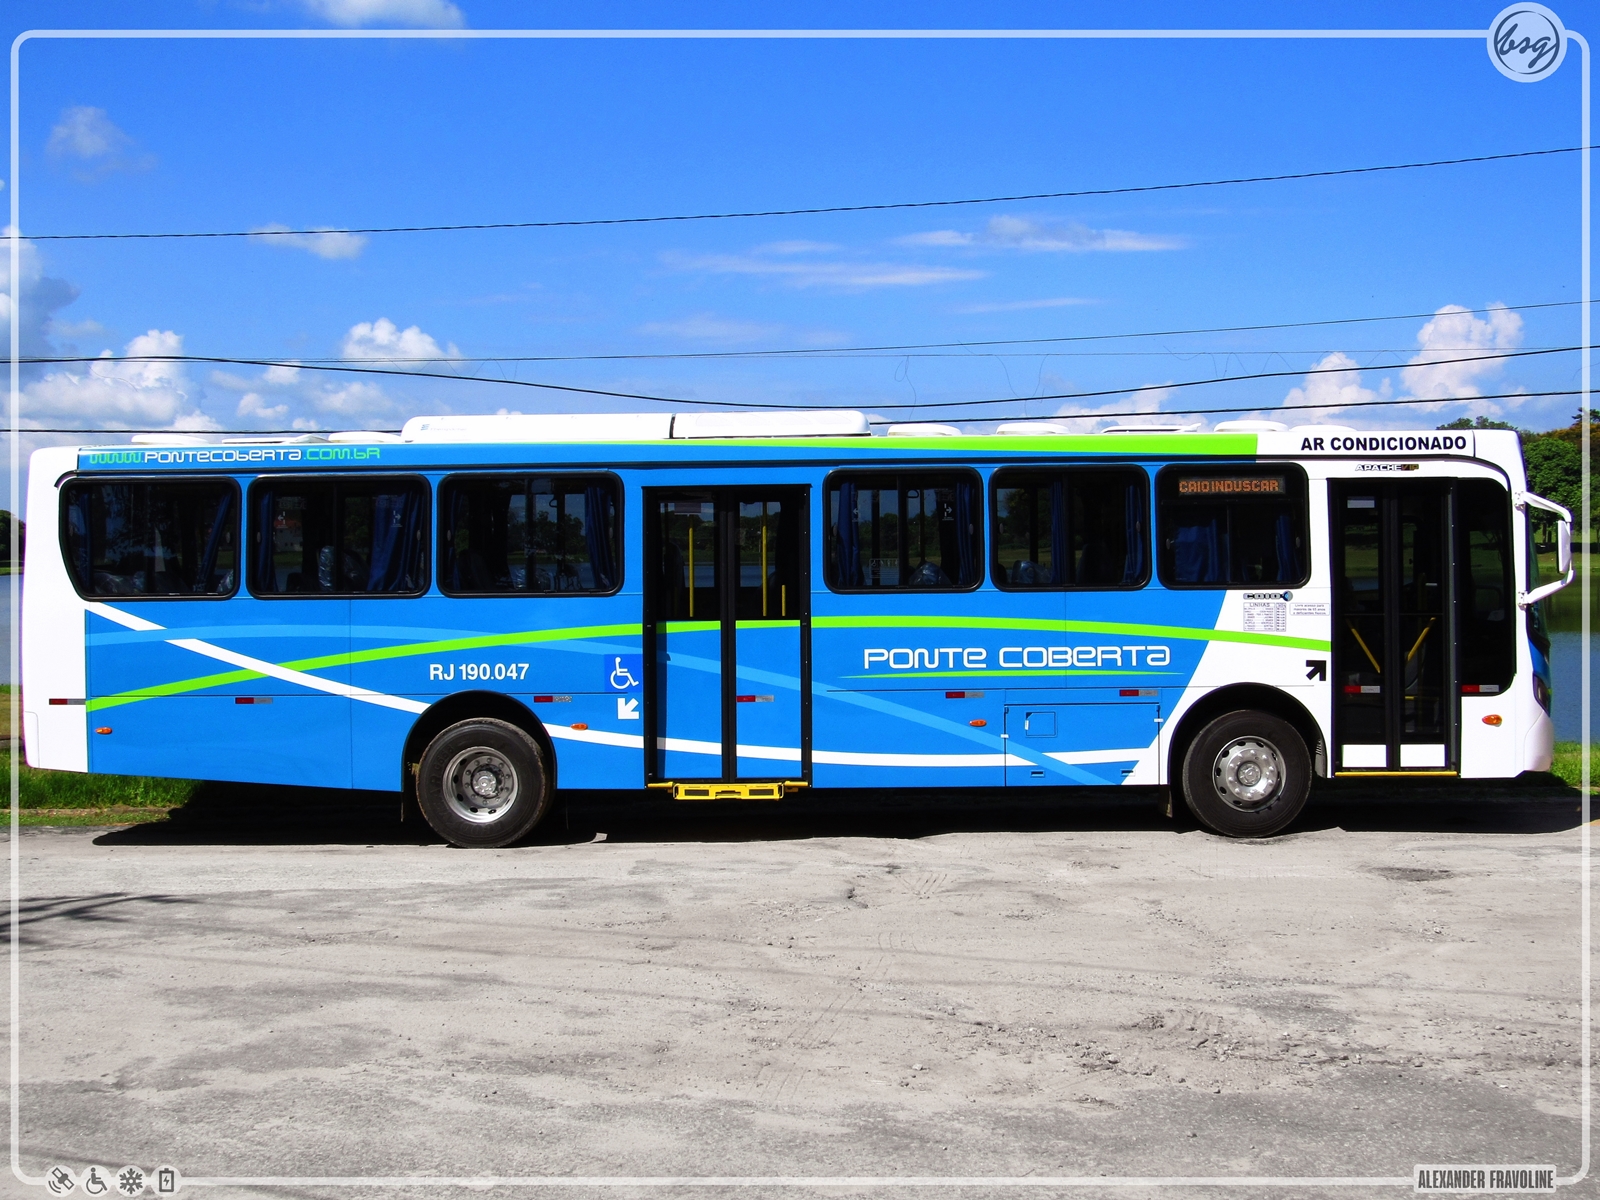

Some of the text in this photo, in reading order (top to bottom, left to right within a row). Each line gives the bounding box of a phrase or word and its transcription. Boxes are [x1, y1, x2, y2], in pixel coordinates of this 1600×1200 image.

[1300, 436, 1467, 451] AR CONDICIONADO
[1355, 463, 1401, 471] APACHE
[1179, 479, 1279, 493] CAIO INDUSCAR
[863, 645, 1171, 669] PONTE COBERTA
[429, 663, 530, 681] RJ 190.047
